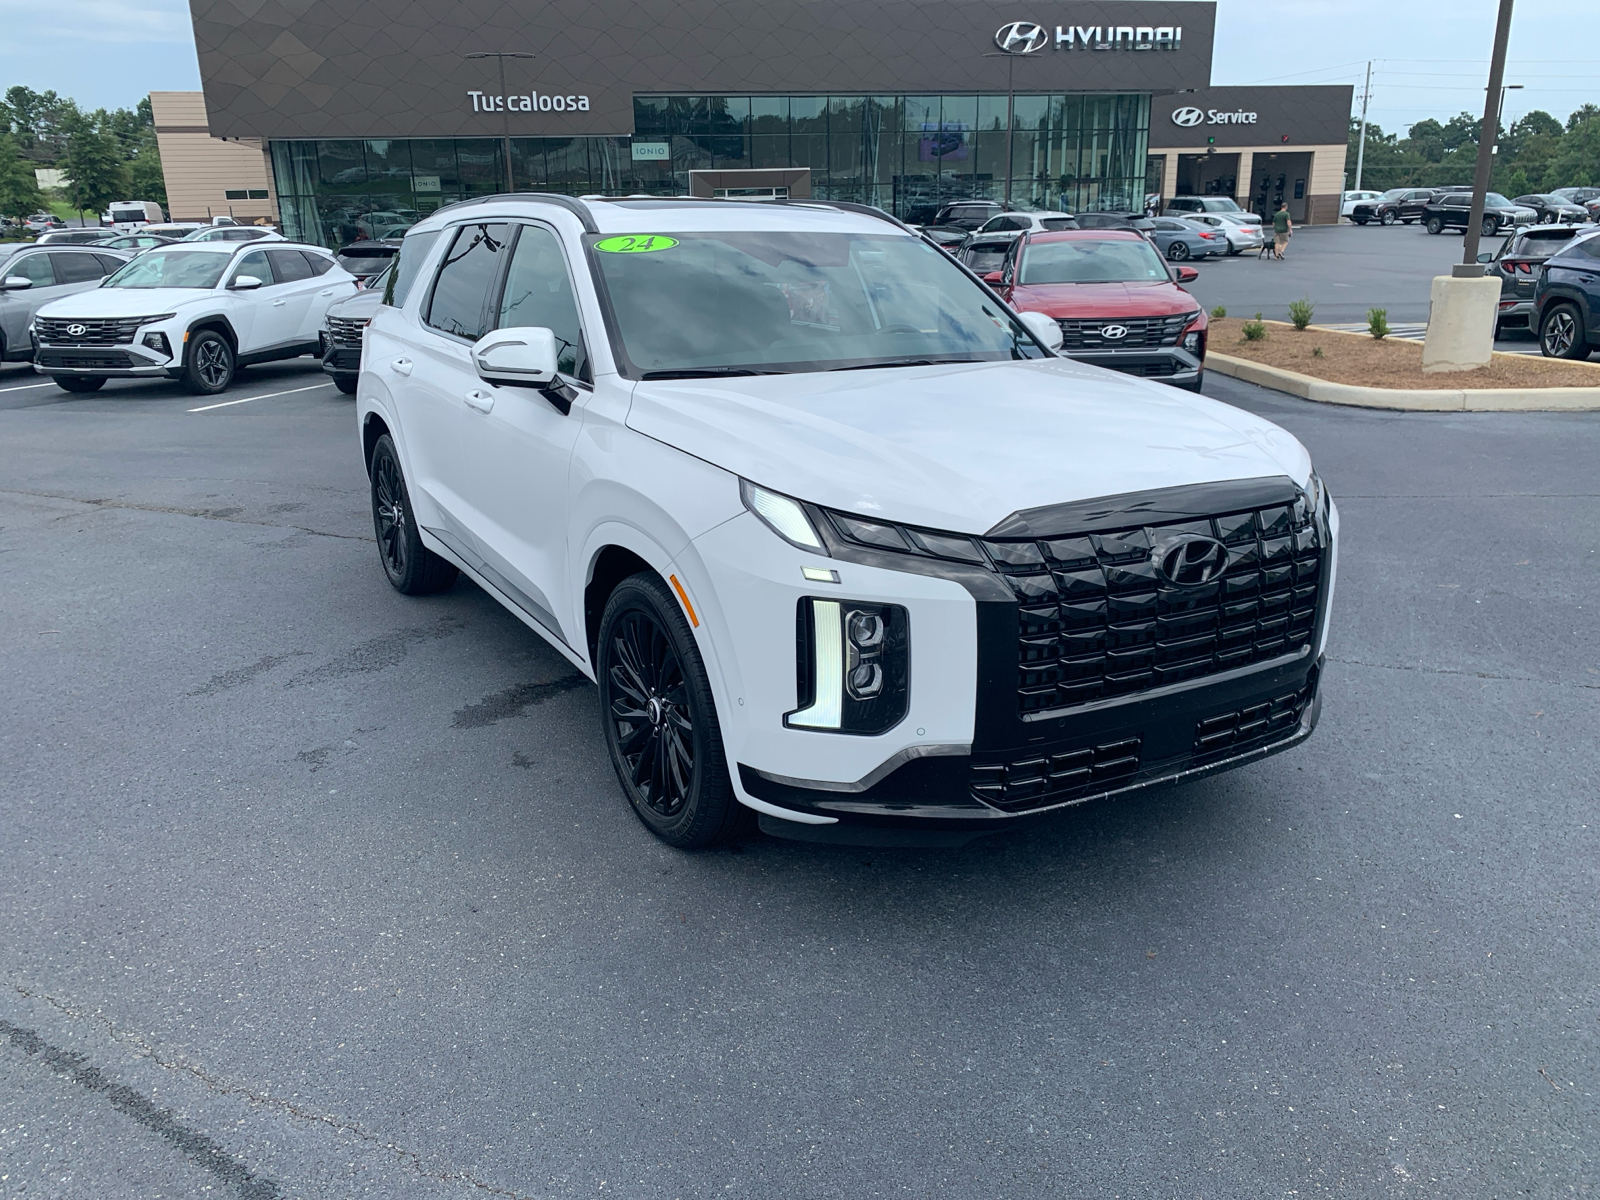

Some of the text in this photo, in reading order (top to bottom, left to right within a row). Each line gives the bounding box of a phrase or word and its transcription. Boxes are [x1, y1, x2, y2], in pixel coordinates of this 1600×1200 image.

[1055, 26, 1182, 50] HYUNDAI
[466, 90, 591, 112] Tuscaloosa
[1206, 108, 1258, 125] Service
[618, 236, 656, 252] 24
